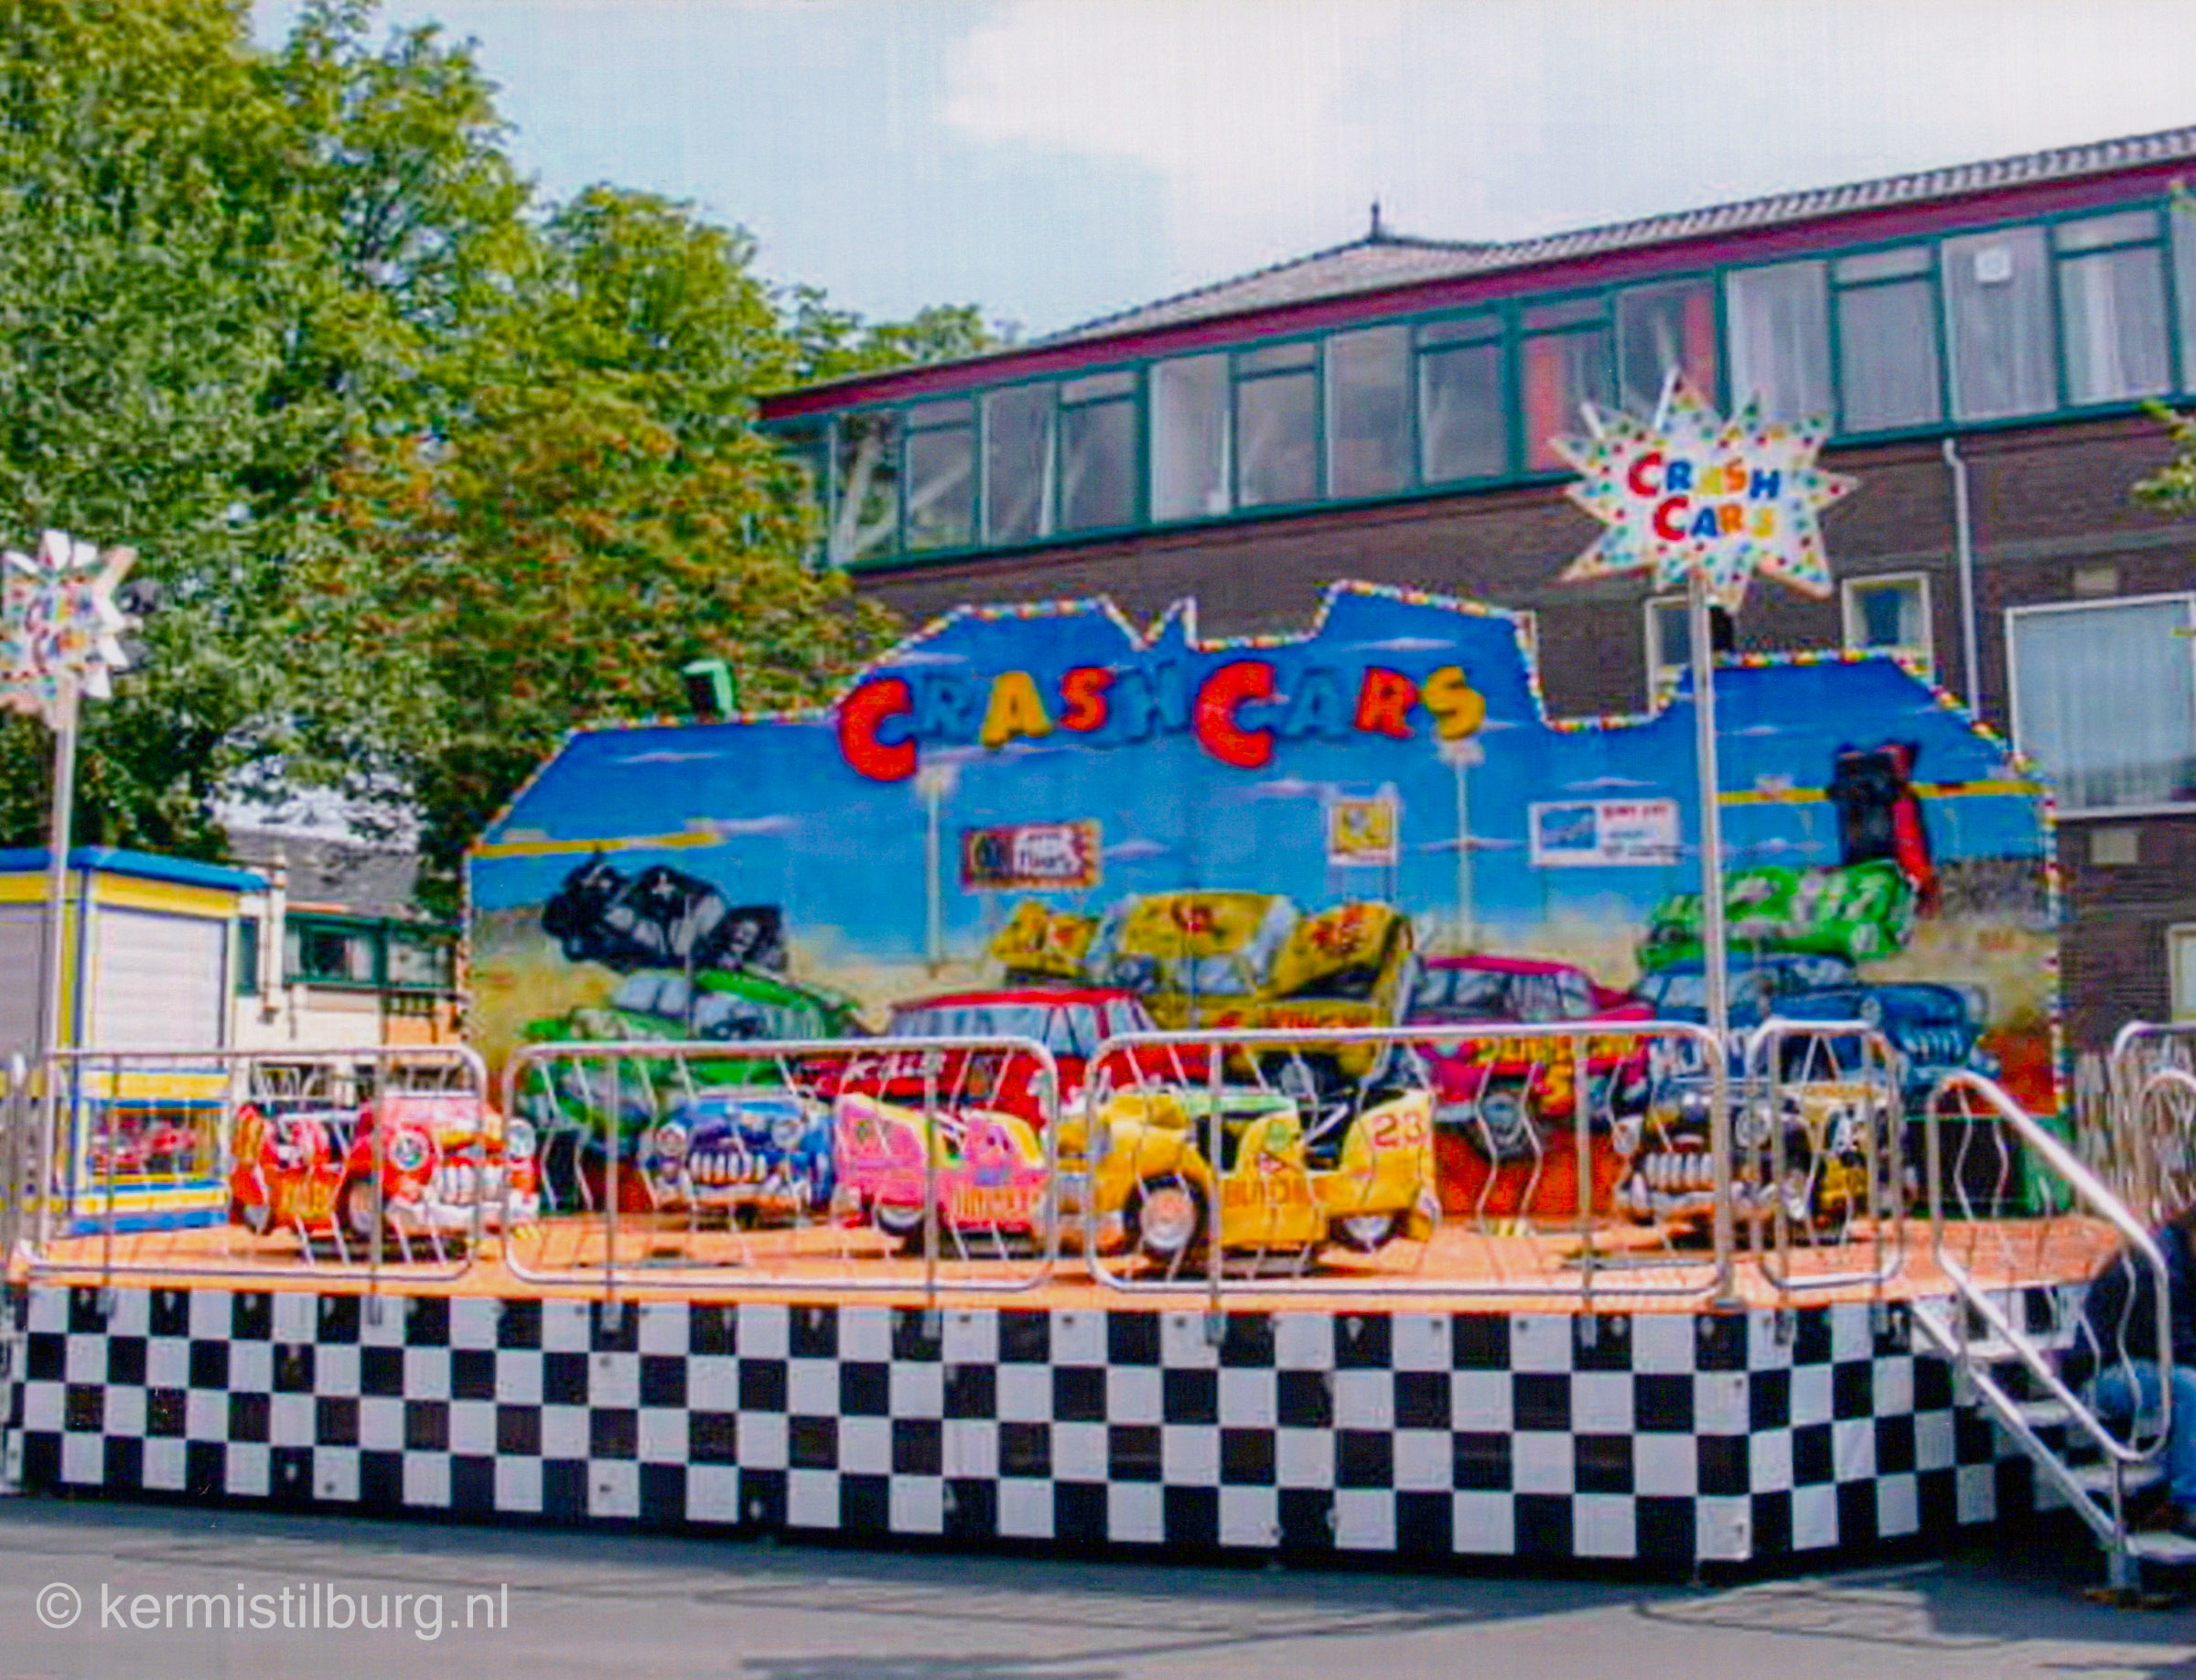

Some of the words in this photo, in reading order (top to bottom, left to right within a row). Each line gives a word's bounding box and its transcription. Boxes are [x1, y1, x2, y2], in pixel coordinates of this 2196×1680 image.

[1628, 452, 1781, 499] CRASH
[1652, 496, 1774, 542] CARS
[837, 662, 1181, 780] CRASH
[1193, 660, 1485, 768] CARS
[1372, 1110, 1425, 1147] 23
